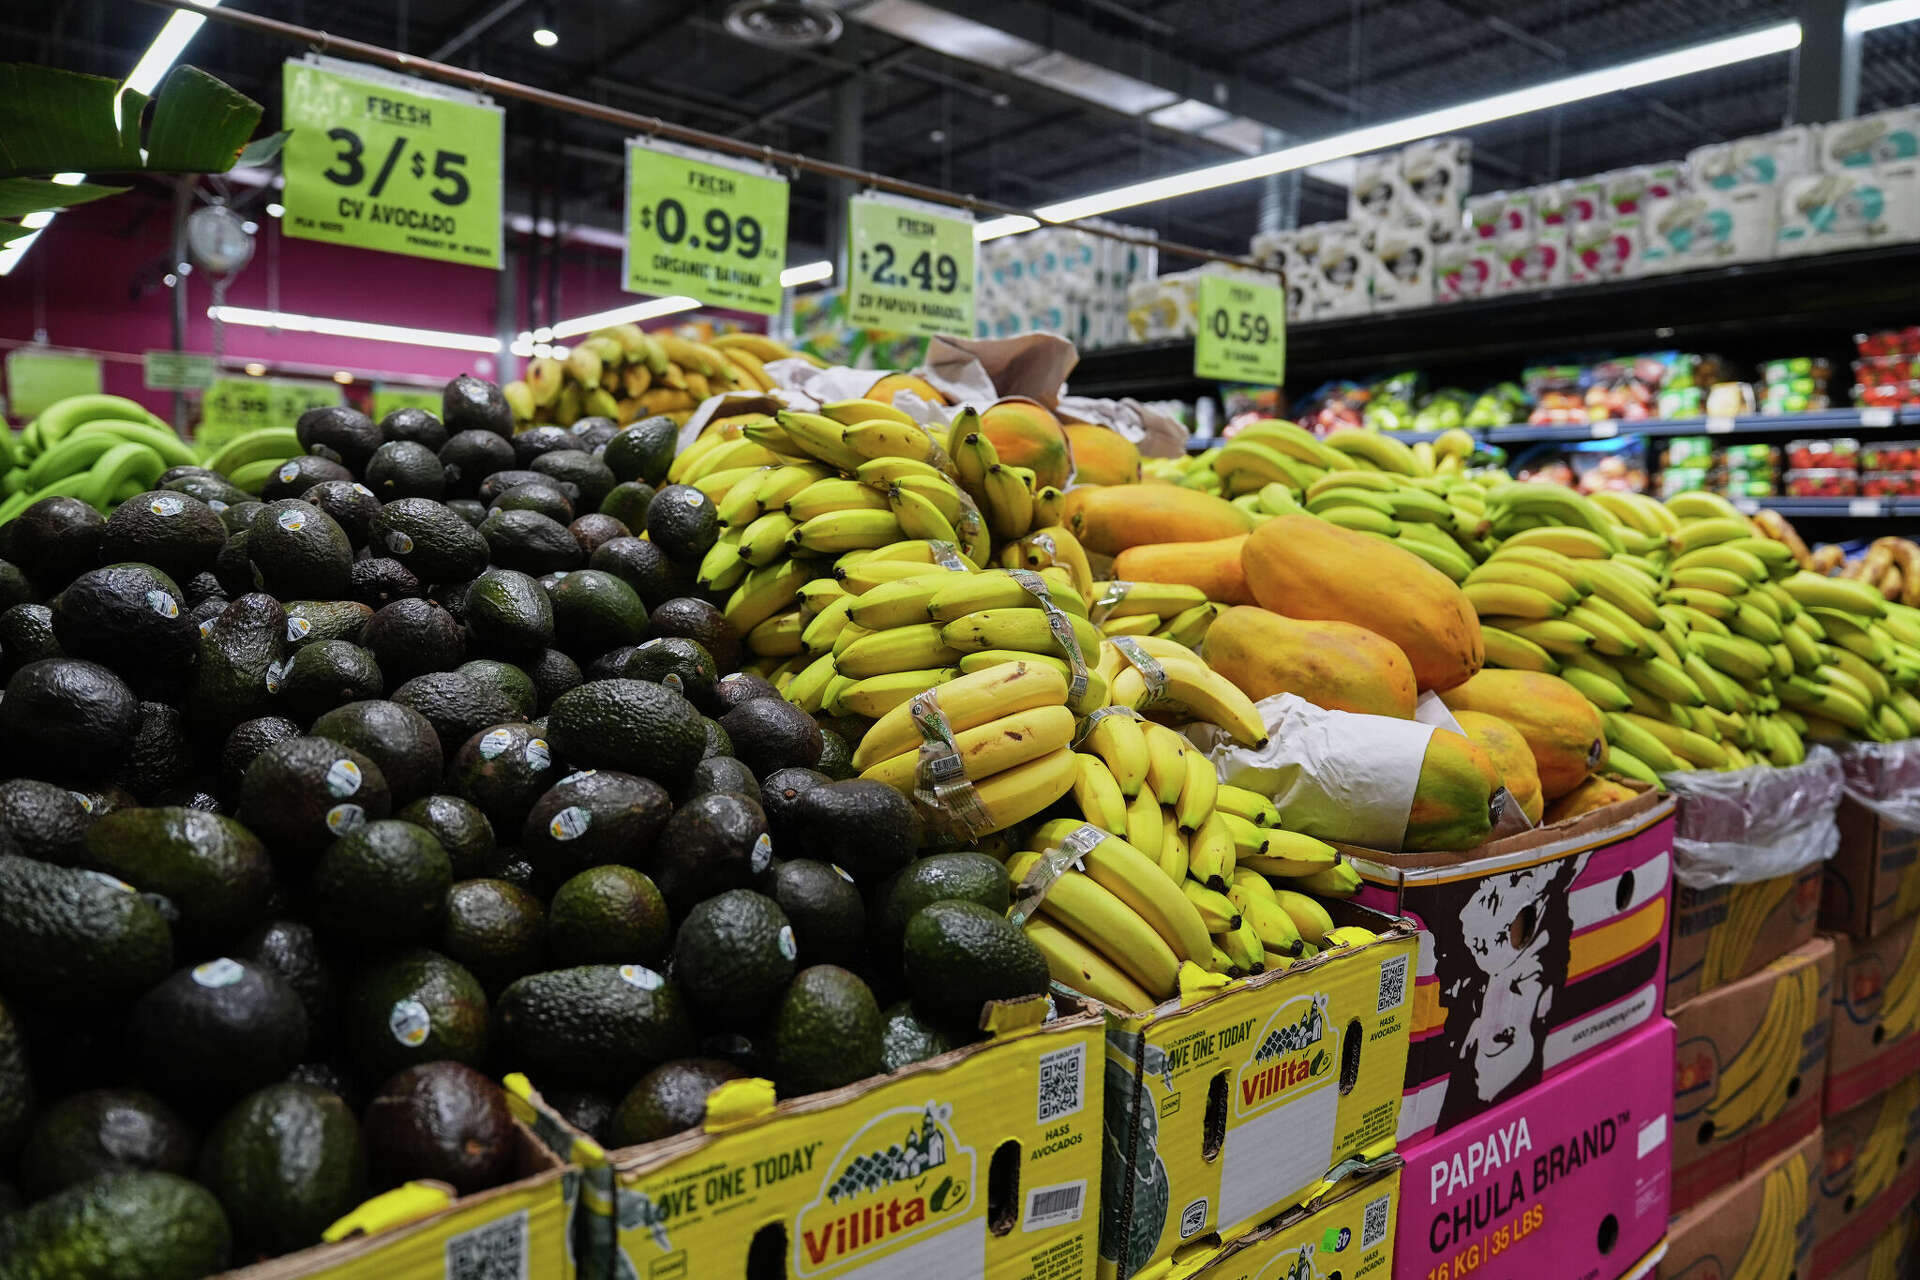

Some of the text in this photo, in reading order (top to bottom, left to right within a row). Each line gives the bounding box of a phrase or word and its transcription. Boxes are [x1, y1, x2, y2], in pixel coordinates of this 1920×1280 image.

[367, 96, 432, 126] FRESH
[323, 127, 470, 206] 3/$5
[688, 171, 735, 194] FRESH
[338, 197, 364, 219] CV
[369, 203, 455, 235] AVOCADO
[640, 198, 762, 260] $0.99
[898, 217, 936, 236] FRESH
[861, 243, 958, 294] $2.49
[1370, 1022, 1401, 1042] AVOCADOS
[1380, 1014, 1395, 1028] HASS
[1192, 1034, 1215, 1062] ONE
[1241, 1057, 1310, 1106] Villita
[1030, 1133, 1083, 1162] AVOCADOS
[1045, 1124, 1070, 1142] HASS
[1430, 1116, 1532, 1204] PAPAYA
[705, 1167, 746, 1206] ONE
[1428, 1170, 1526, 1254] CHULA
[803, 1197, 925, 1265] Villita
[1454, 1244, 1480, 1278] KG
[1491, 1225, 1510, 1255] 35
[1513, 1203, 1544, 1242] LBS
[1354, 1256, 1386, 1280] AVOCADOS
[1363, 1249, 1379, 1263] HASS
